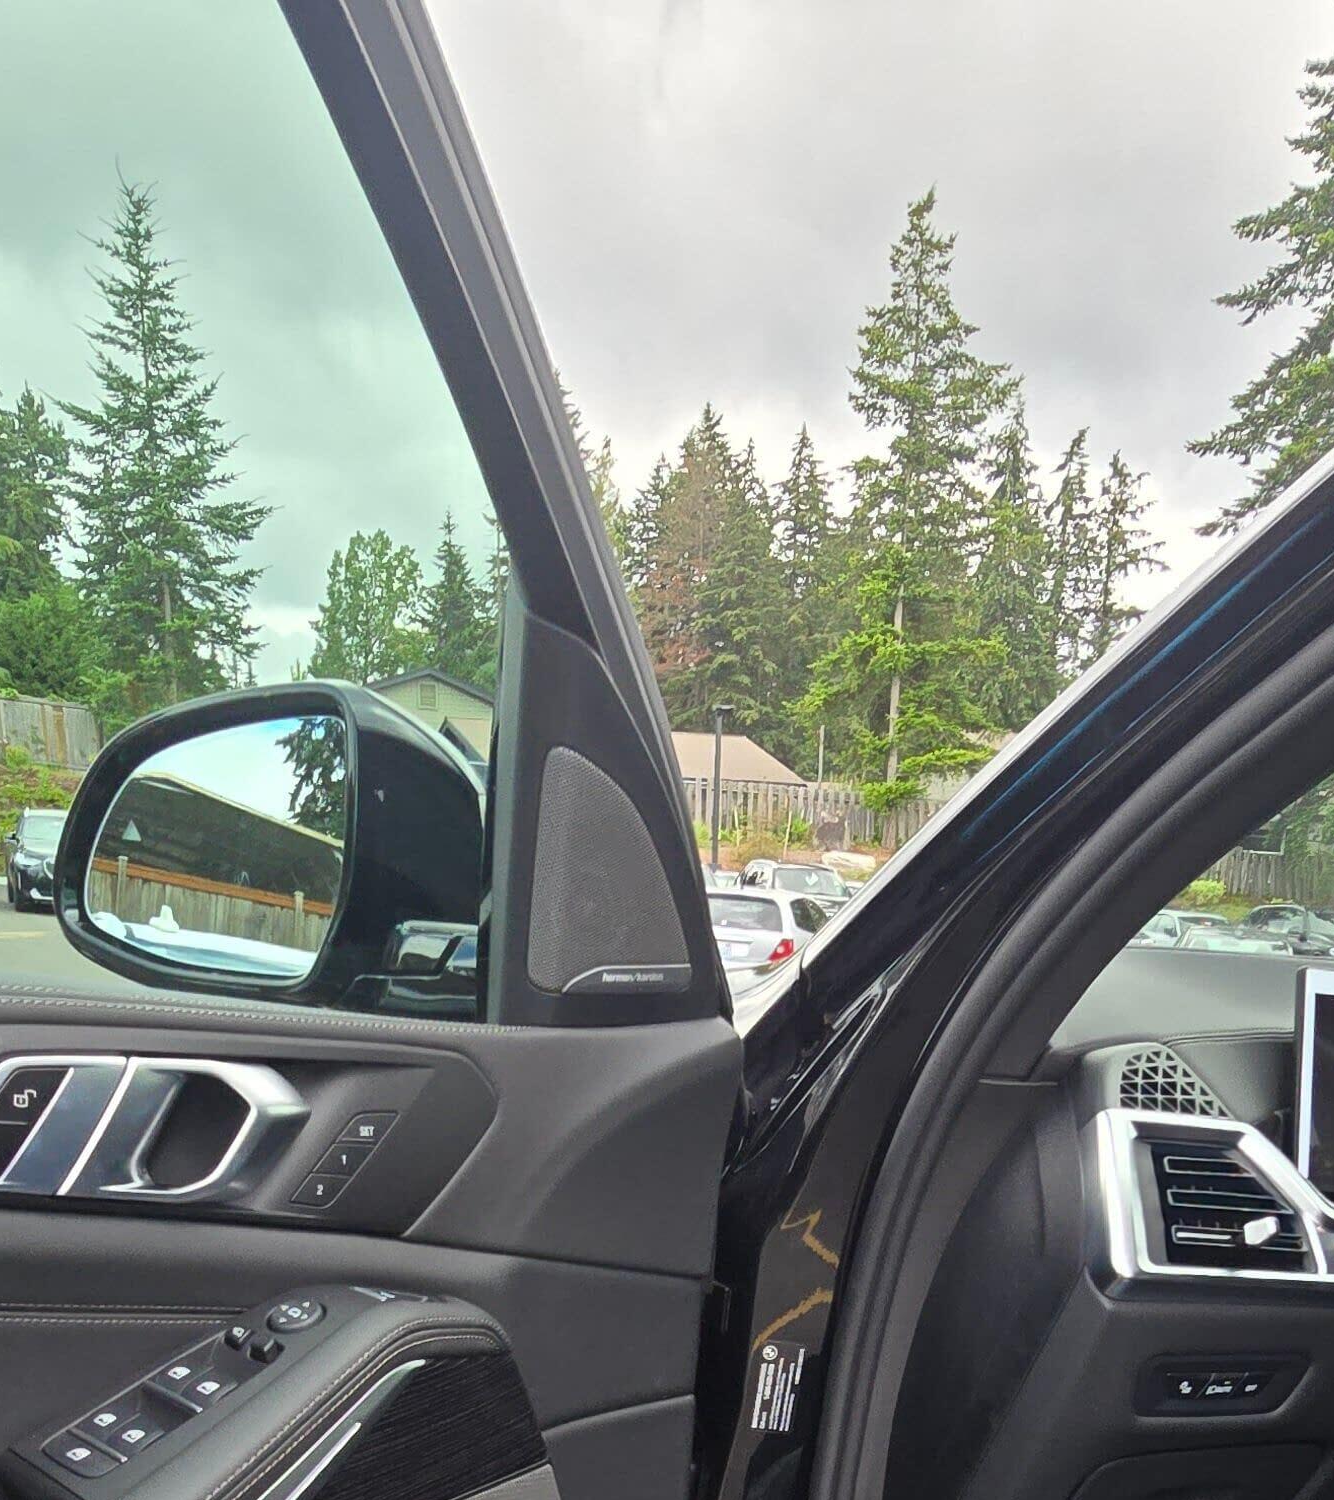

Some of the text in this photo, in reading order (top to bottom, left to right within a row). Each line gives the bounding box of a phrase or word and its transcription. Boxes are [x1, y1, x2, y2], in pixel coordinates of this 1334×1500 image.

[359, 1125, 375, 1137] SET
[341, 1154, 347, 1166] 1
[316, 1184, 324, 1196] 2
